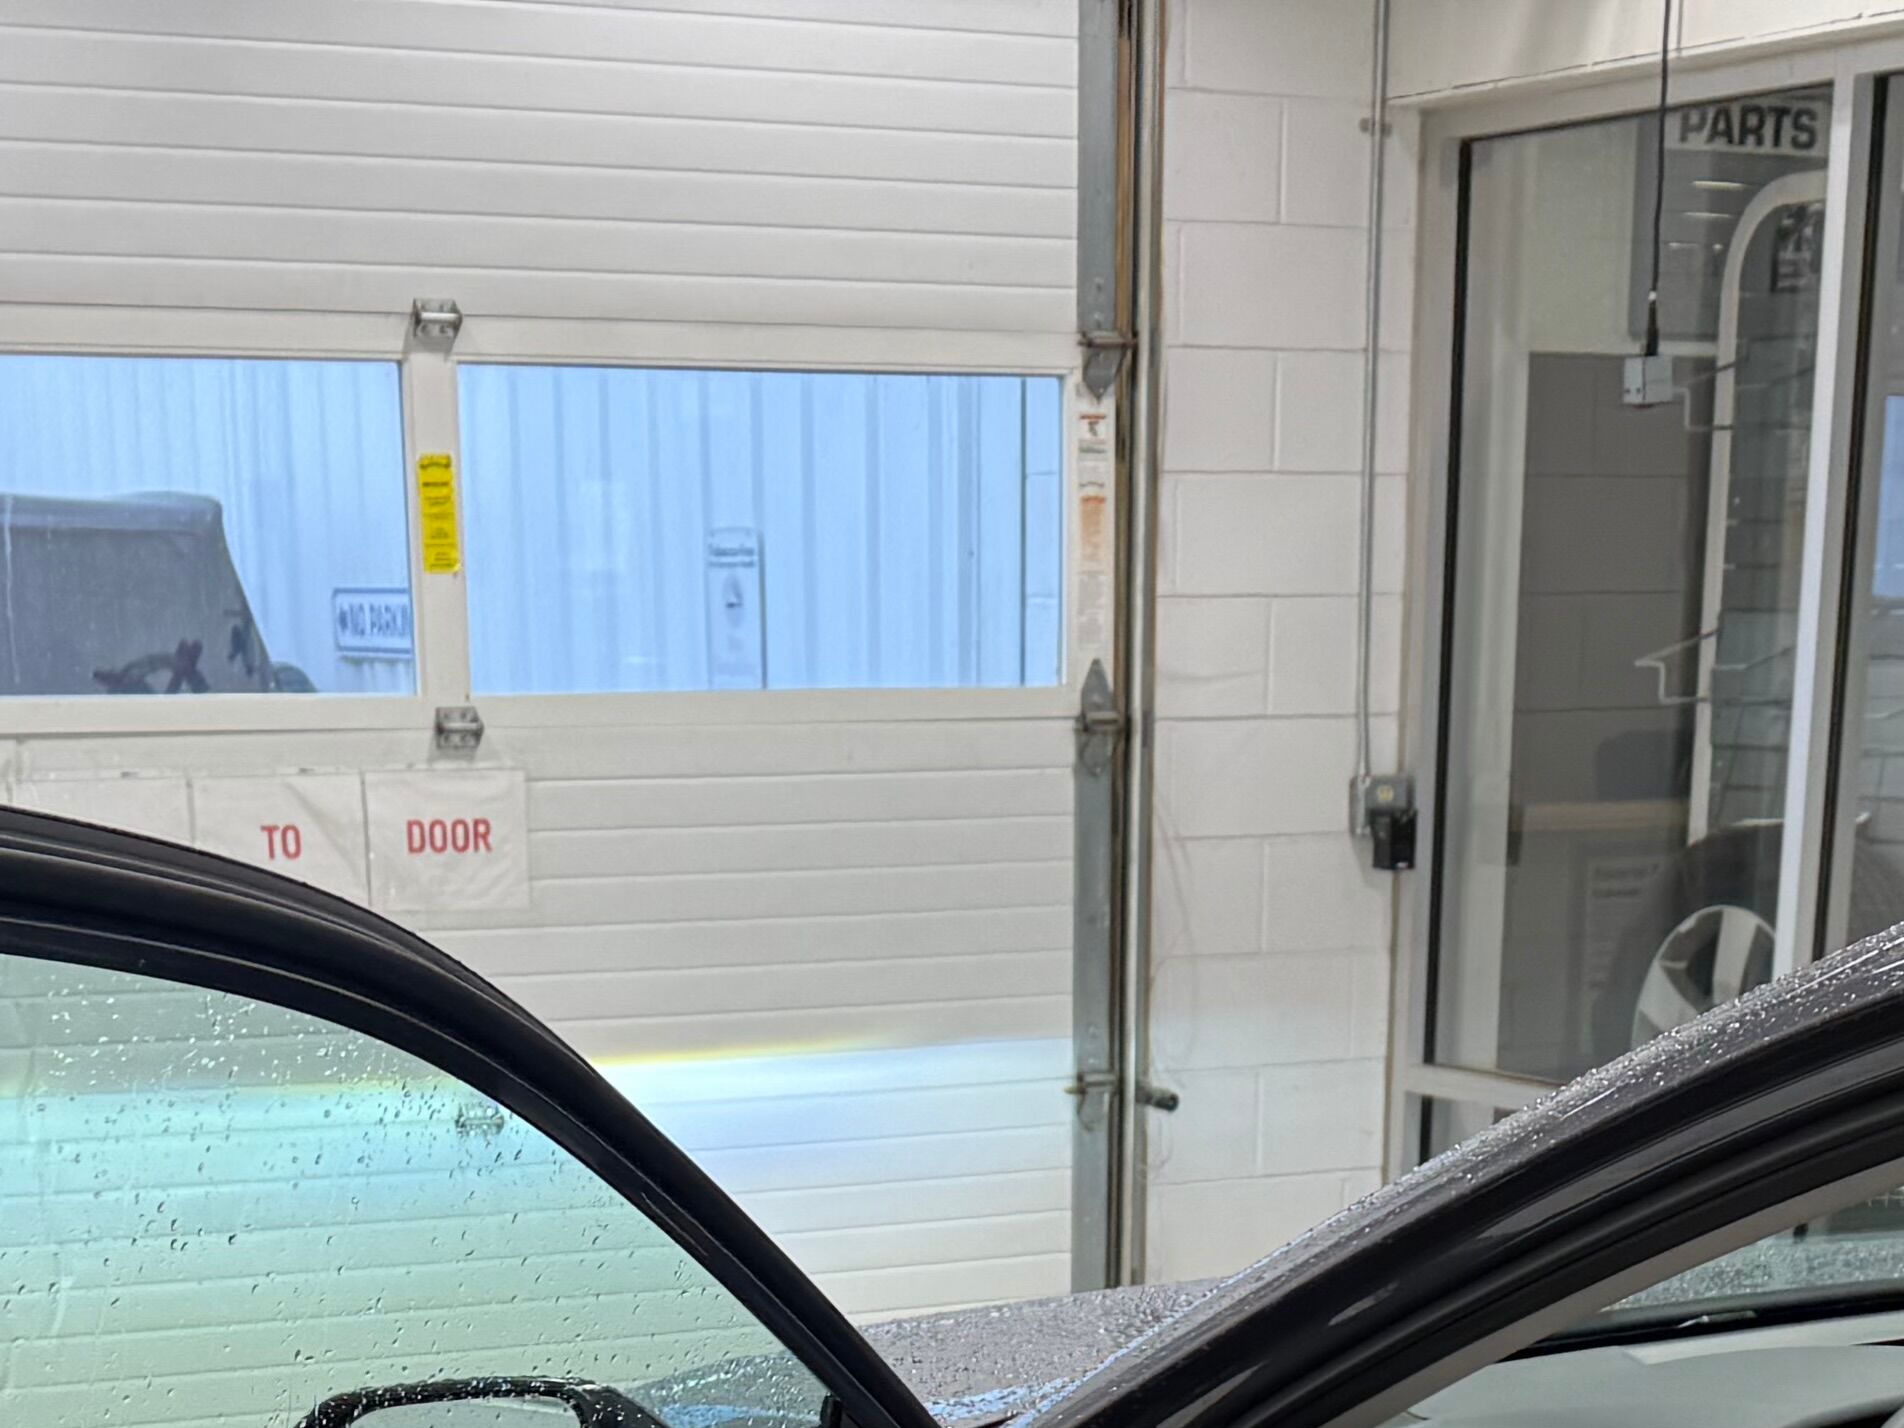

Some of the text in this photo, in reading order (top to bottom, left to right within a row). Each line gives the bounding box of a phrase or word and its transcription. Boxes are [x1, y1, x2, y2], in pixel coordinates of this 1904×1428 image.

[1680, 104, 1818, 150] PARTS
[260, 817, 493, 861] TO DOOR
